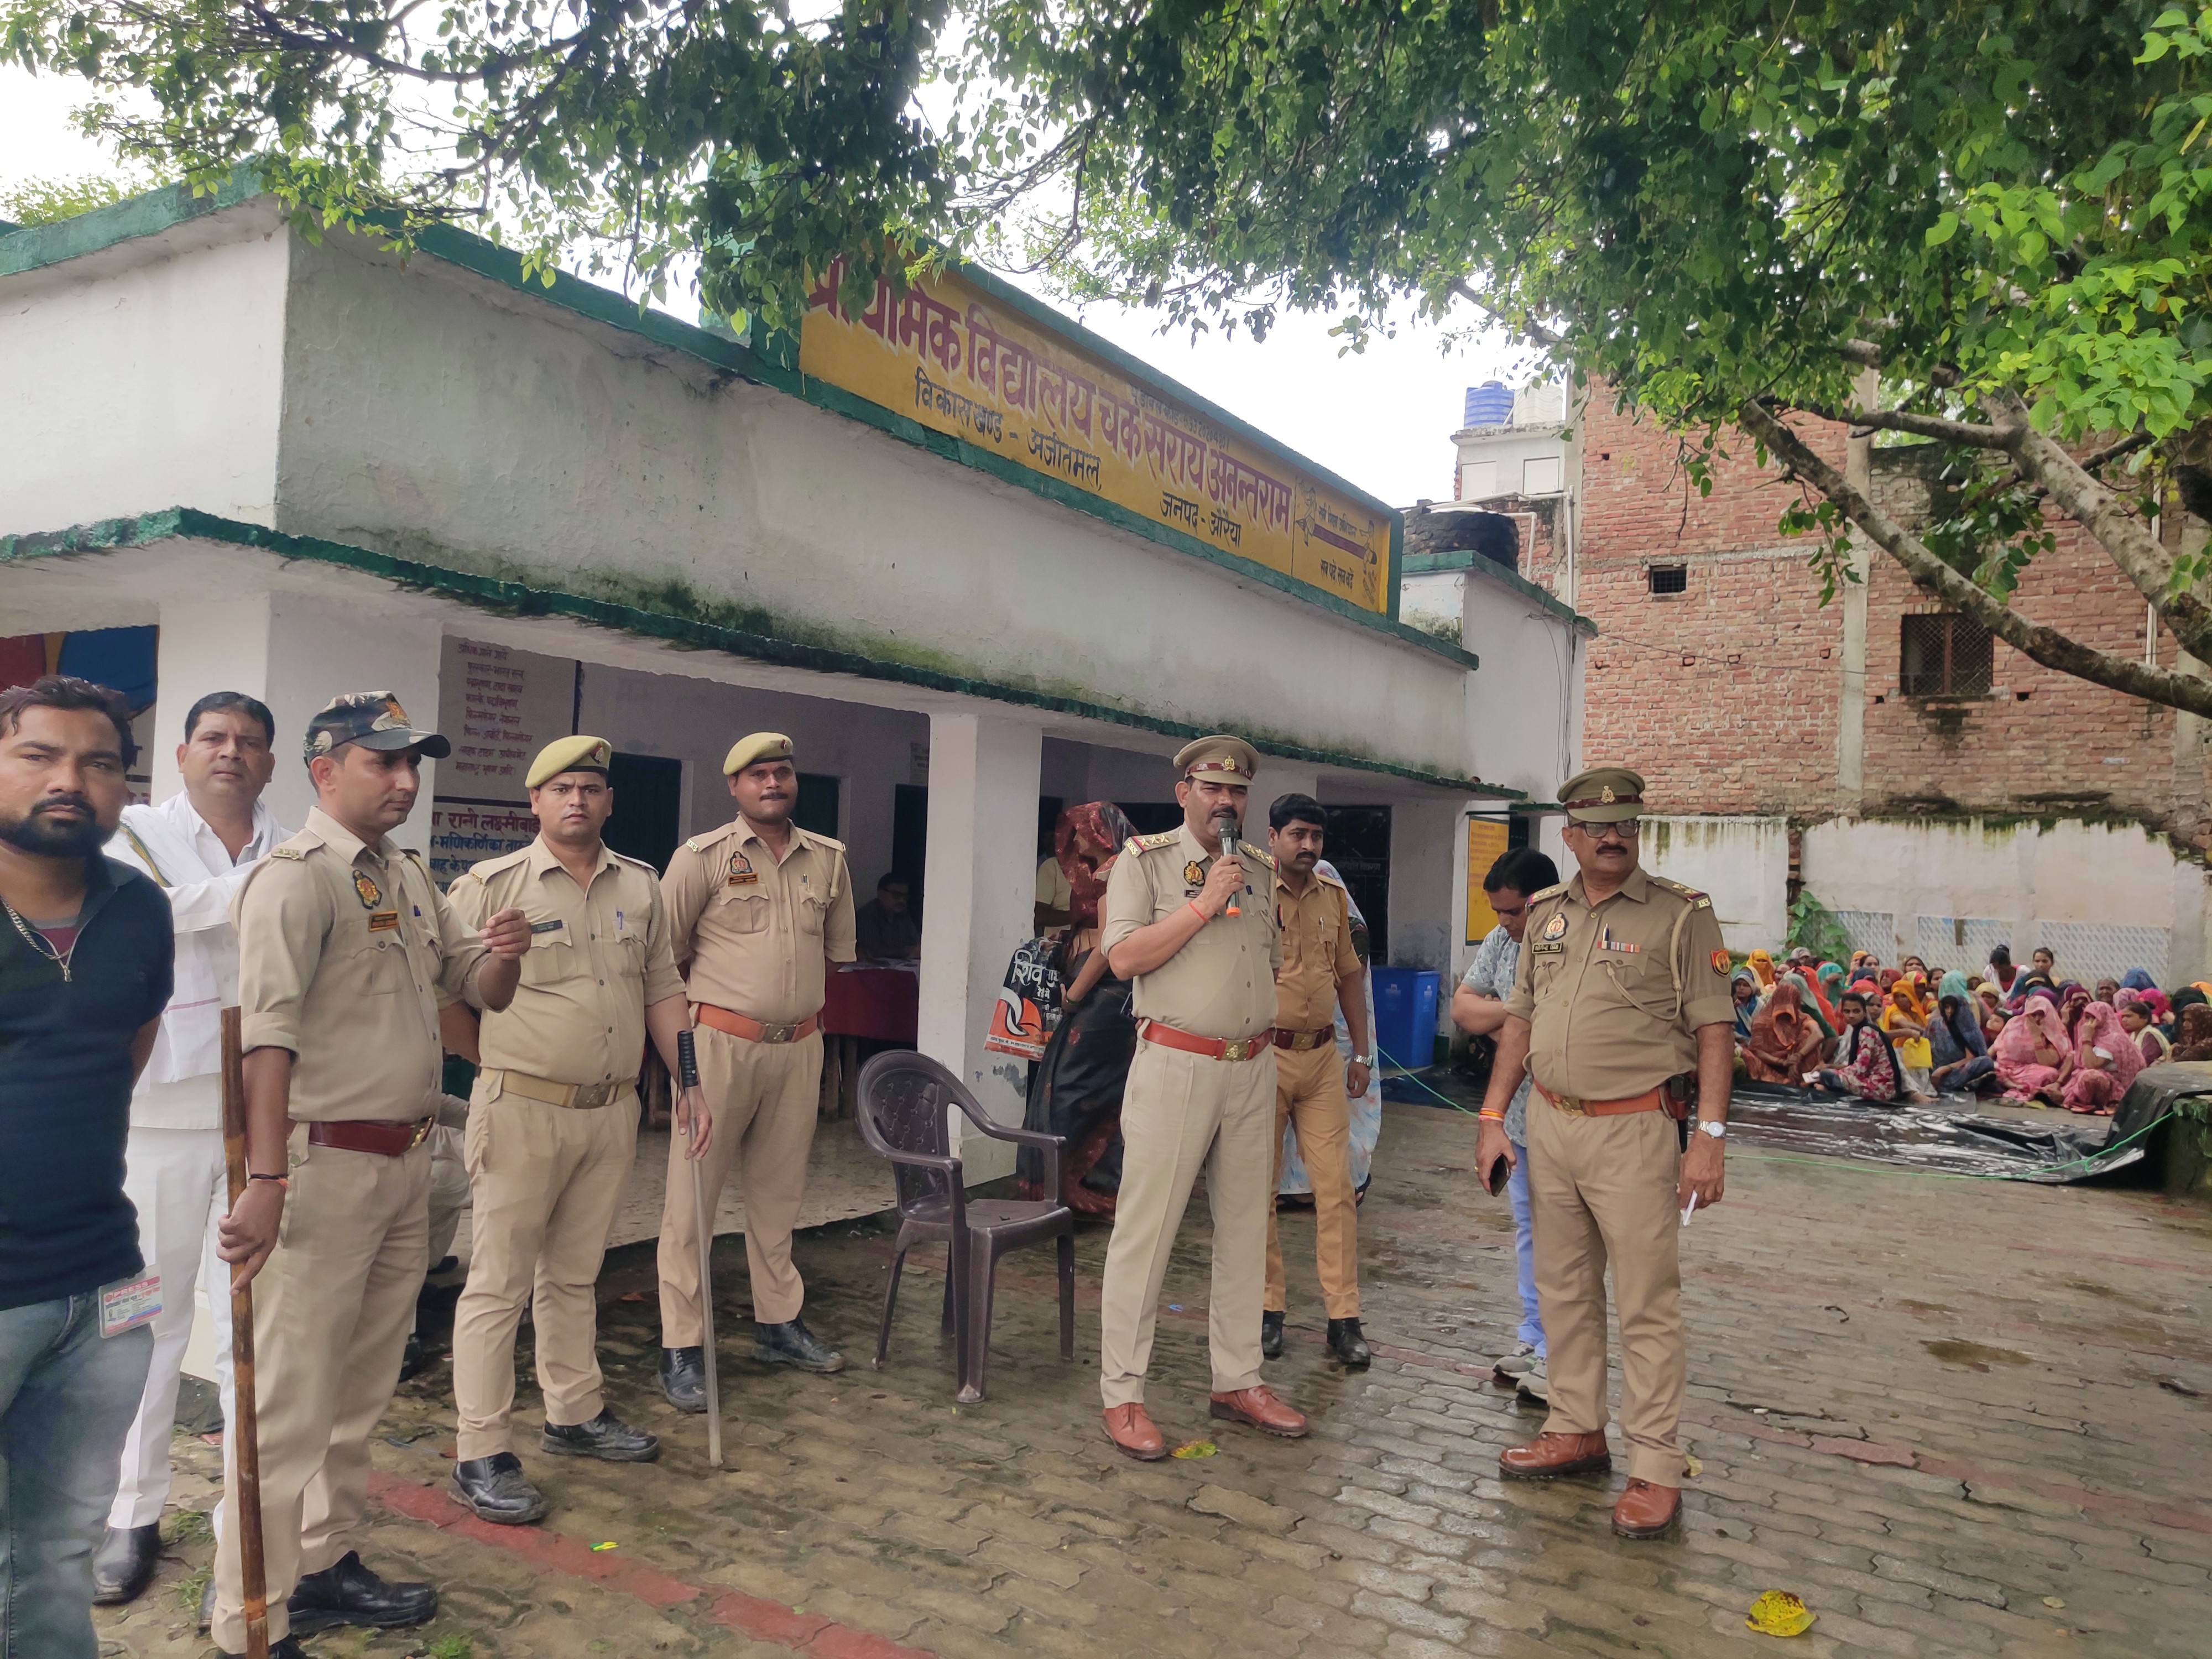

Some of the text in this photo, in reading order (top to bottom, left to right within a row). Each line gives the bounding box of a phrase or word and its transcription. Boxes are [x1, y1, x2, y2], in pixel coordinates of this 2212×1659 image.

[915, 366, 973, 423] विकास
[1160, 491, 1199, 535] जनपद
[964, 302, 1097, 441] विद्यालय
[1208, 448, 1292, 534] अनन्तराम
[447, 807, 479, 828] रानी
